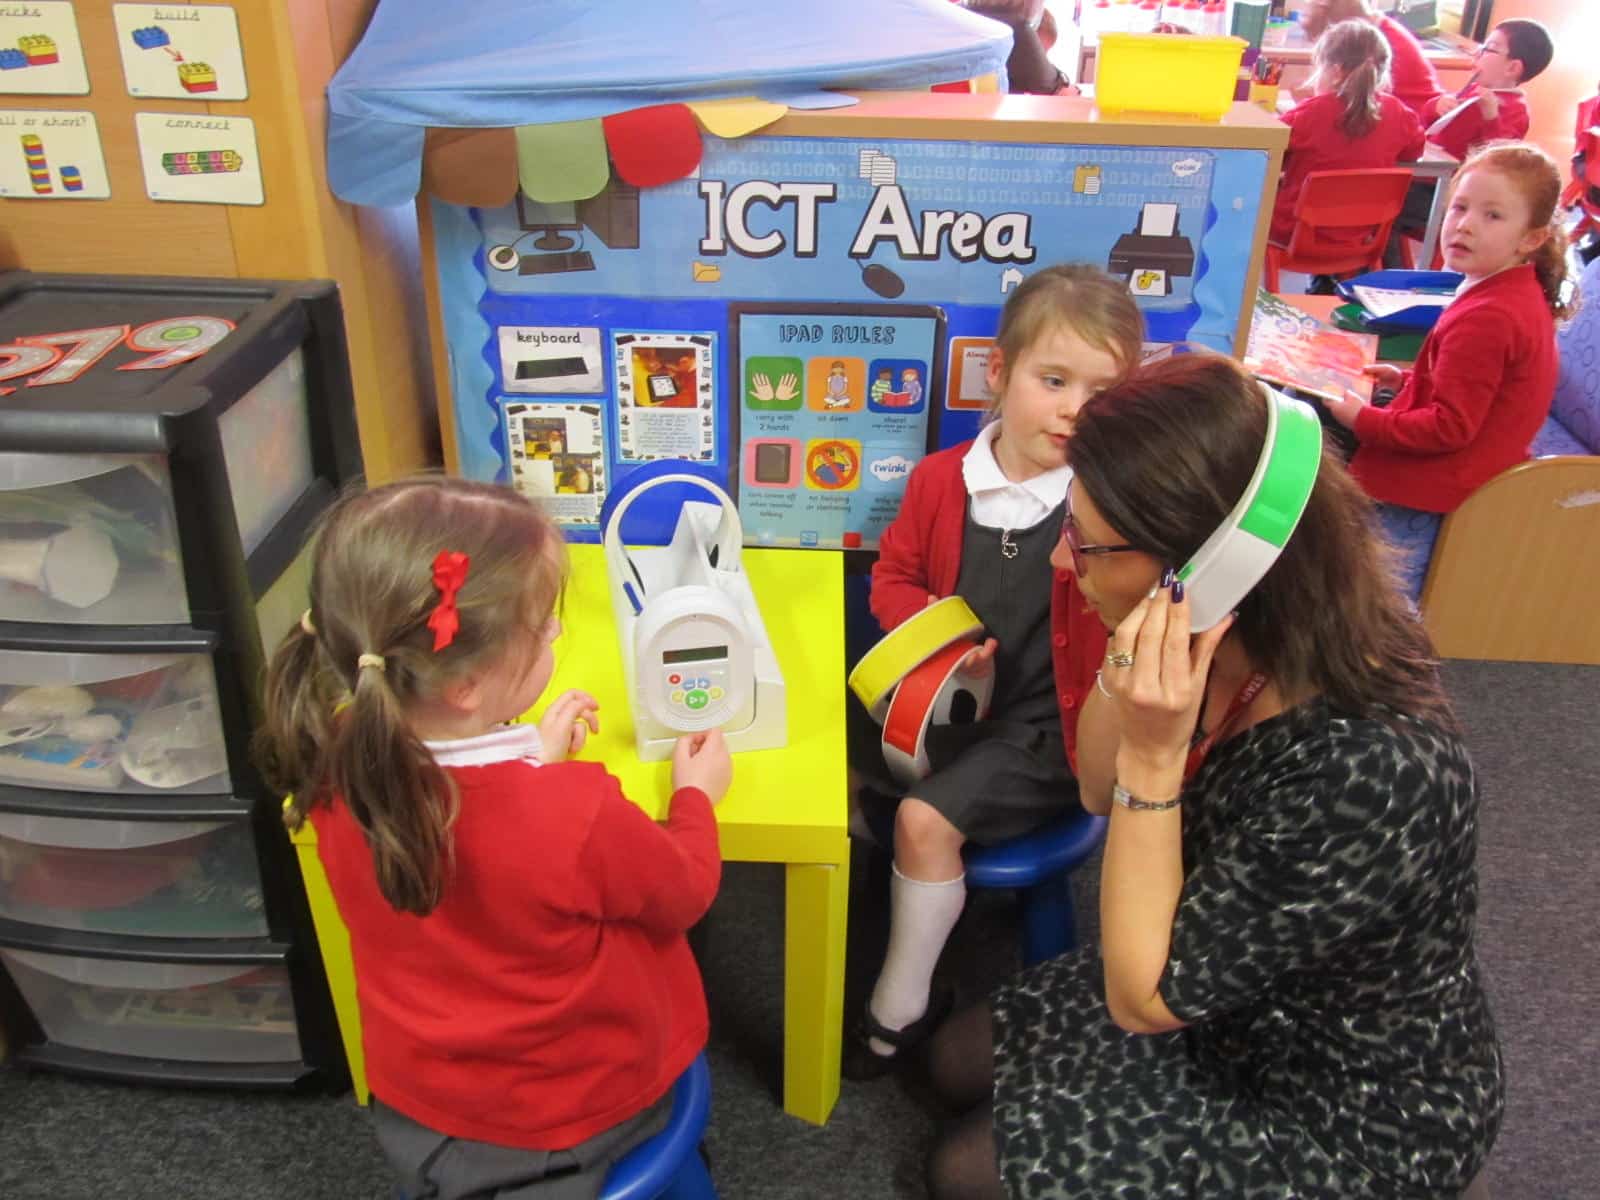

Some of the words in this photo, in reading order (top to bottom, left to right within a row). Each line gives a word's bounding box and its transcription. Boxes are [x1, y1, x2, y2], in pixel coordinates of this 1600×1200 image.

[0, 5, 43, 17] ricks
[153, 7, 200, 21] build
[24, 118, 40, 126] or
[164, 119, 231, 130] connect
[698, 180, 838, 258] ICT
[849, 184, 1037, 265] Area
[516, 330, 581, 347] keyboard
[779, 323, 825, 343] IPAD
[831, 324, 896, 345] RULES
